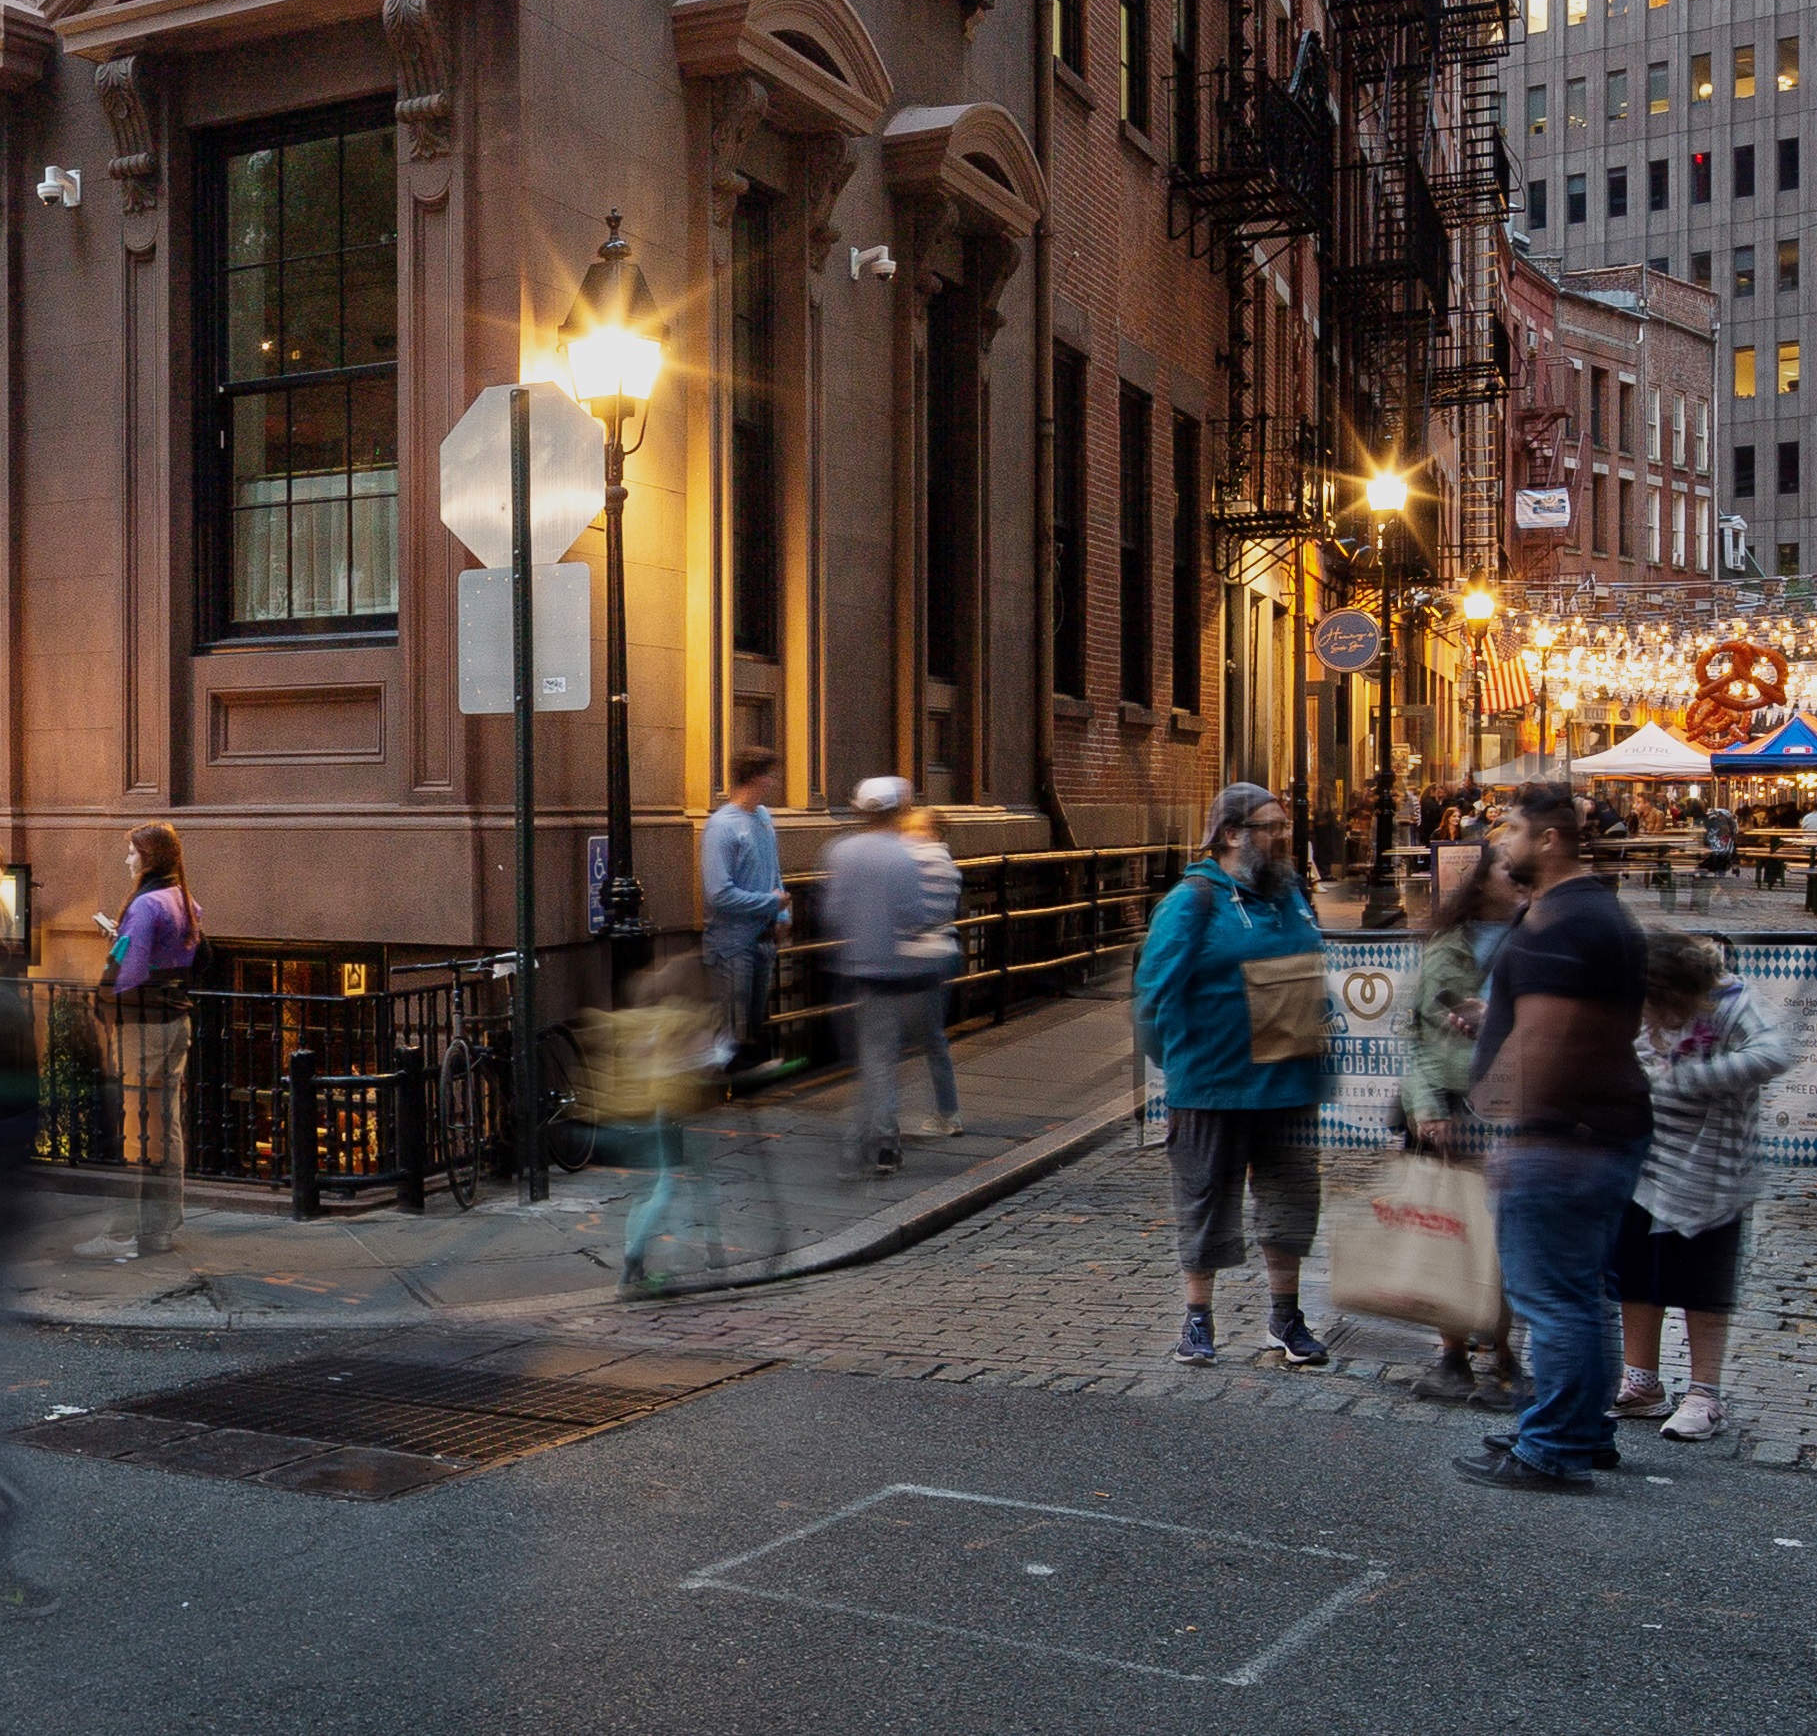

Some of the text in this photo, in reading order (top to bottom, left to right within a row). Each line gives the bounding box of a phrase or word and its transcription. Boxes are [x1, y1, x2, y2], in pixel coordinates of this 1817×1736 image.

[1784, 996, 1804, 1007] Stein
[1316, 1039, 1414, 1054] STONE STREE
[1314, 1055, 1412, 1075] KTOBERFE
[1330, 1086, 1401, 1098] CELEBRATI
